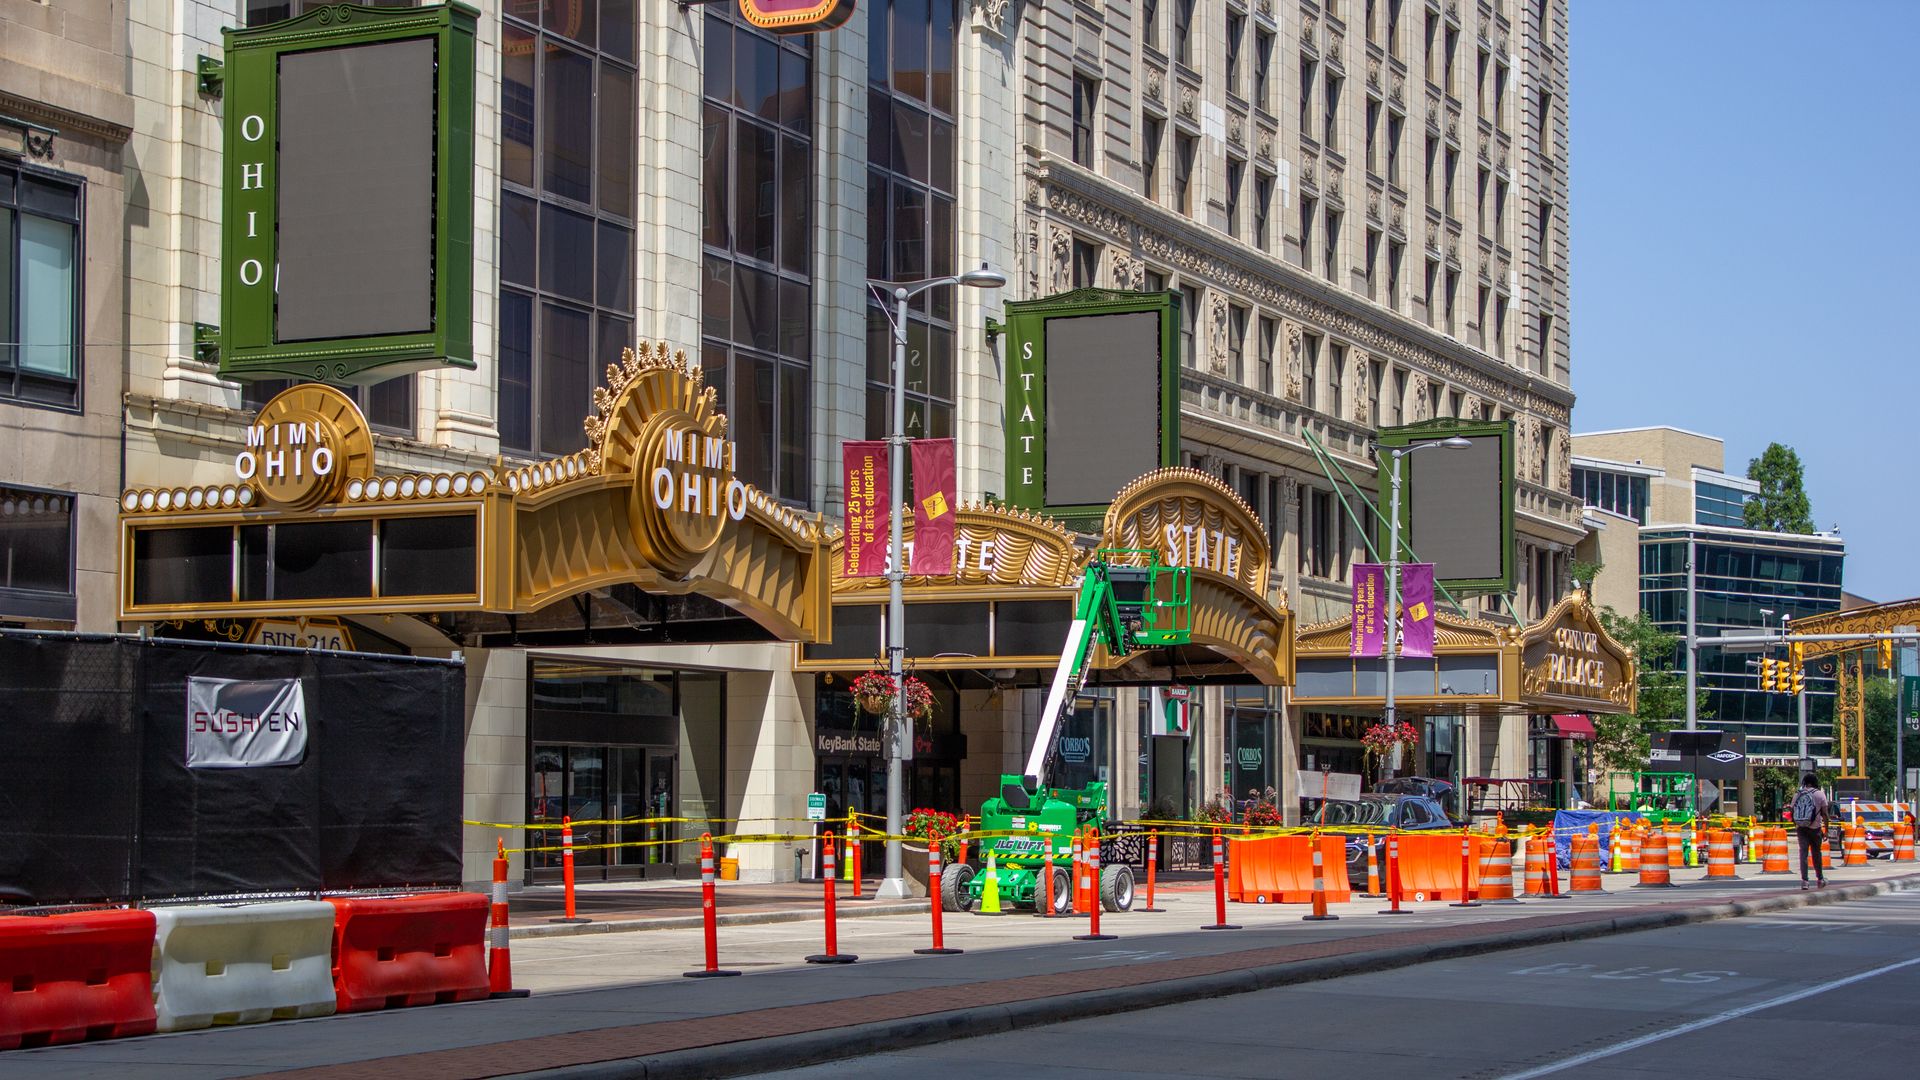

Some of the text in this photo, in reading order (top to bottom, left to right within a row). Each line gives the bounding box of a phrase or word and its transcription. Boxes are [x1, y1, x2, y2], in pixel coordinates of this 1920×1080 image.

[240, 115, 264, 287] OHIO
[1018, 342, 1036, 485] STATE
[247, 422, 322, 447] MIMI
[663, 429, 737, 472] MIMI
[235, 447, 334, 480] OHIO
[652, 468, 748, 521] OHIO
[862, 455, 874, 543] of arts education
[847, 469, 863, 575] Celebrating 25 years
[1166, 523, 1238, 578] STATE
[1354, 582, 1366, 655] Celebrating 25 years
[1365, 573, 1375, 634] of arts education
[262, 631, 341, 651] BIN 216
[1556, 627, 1598, 654] CONNOR
[1548, 653, 1604, 688] PALACE
[194, 712, 299, 733] SUSHI EN
[1911, 711, 1920, 731] CSU
[818, 735, 881, 753] KeyBank State
[1060, 736, 1091, 757] CORBO'S
[994, 839, 1045, 851] JLG LIFT
